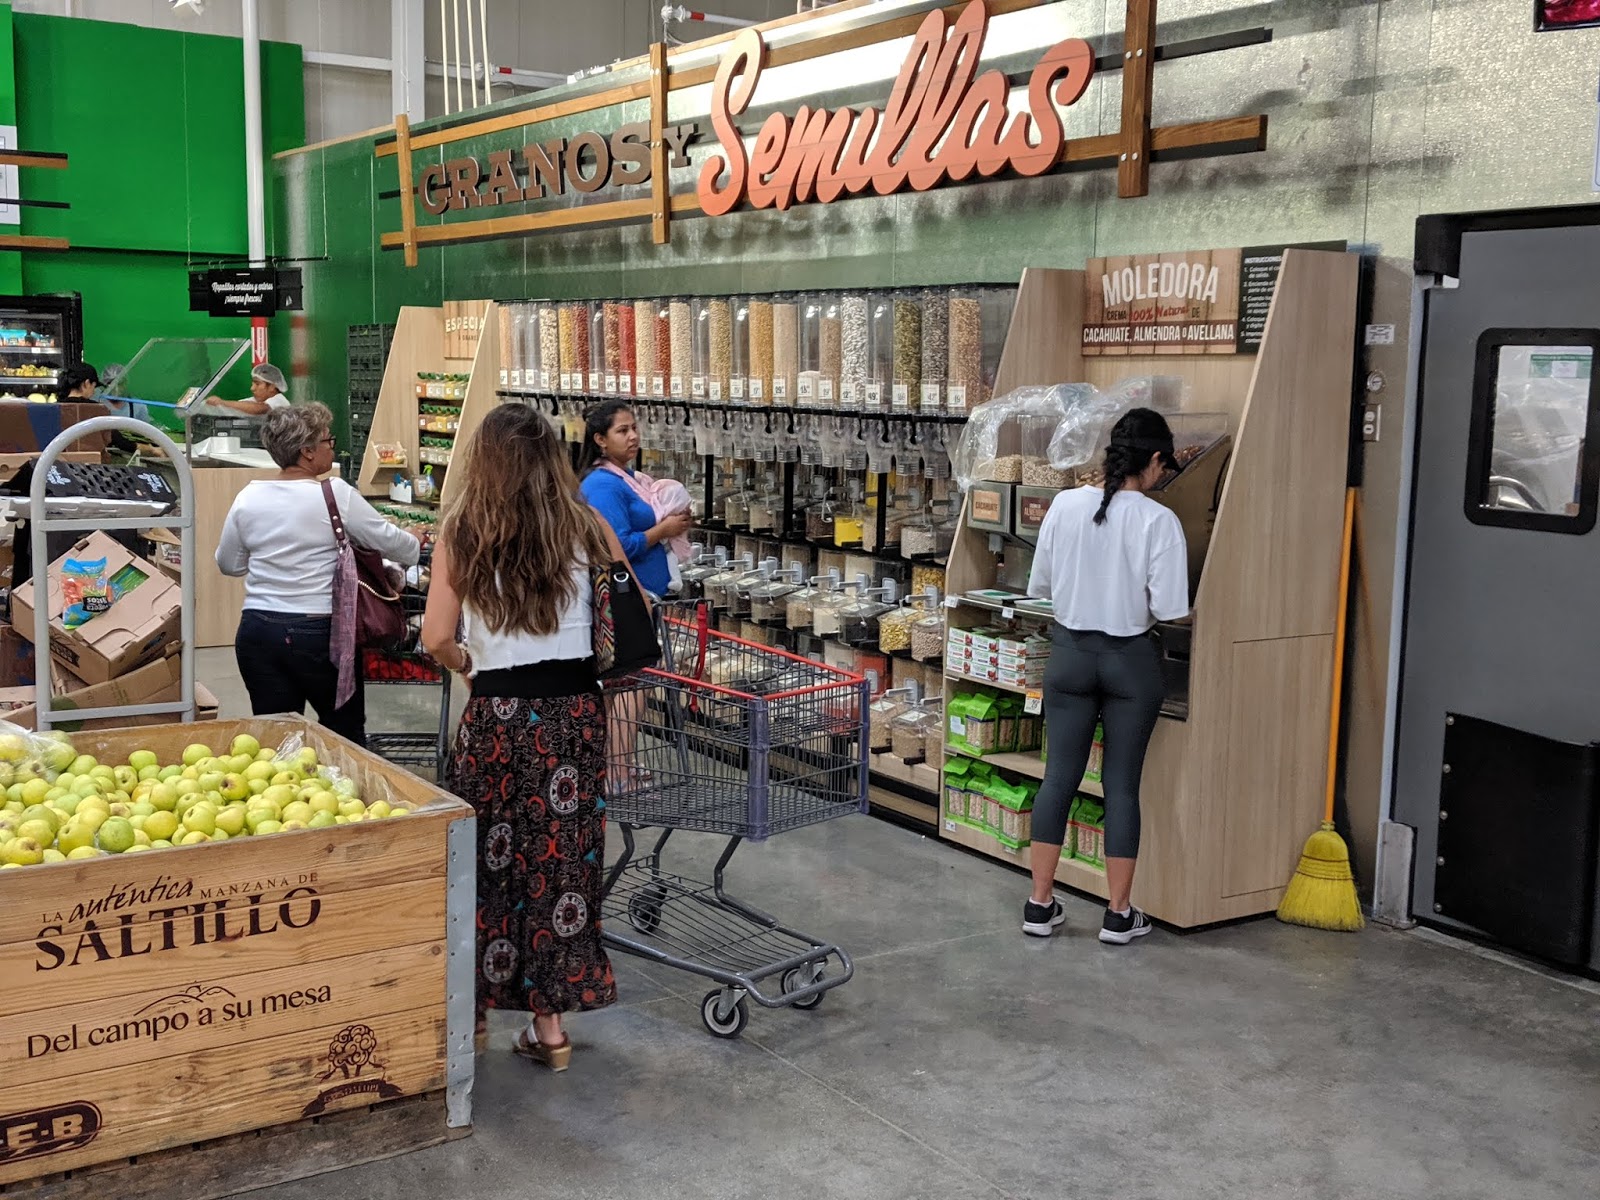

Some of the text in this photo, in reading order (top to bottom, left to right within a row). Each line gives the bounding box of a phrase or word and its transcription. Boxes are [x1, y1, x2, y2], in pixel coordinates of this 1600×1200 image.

[418, 0, 1096, 216] GRANOS Y Semillas
[1102, 262, 1219, 308] MOLEDORA
[1083, 326, 1132, 343] CACAHUATE,
[1133, 325, 1181, 341] ALMENDRA
[1187, 323, 1235, 341] AVELLANA
[1106, 310, 1127, 321] CREMA
[1156, 304, 1190, 318] Natural
[1191, 307, 1201, 318] DE
[42, 872, 319, 924] LA auténtica MANZANA DE
[35, 887, 322, 971] SALTILLO
[28, 985, 331, 1058] Del campo a su mesa
